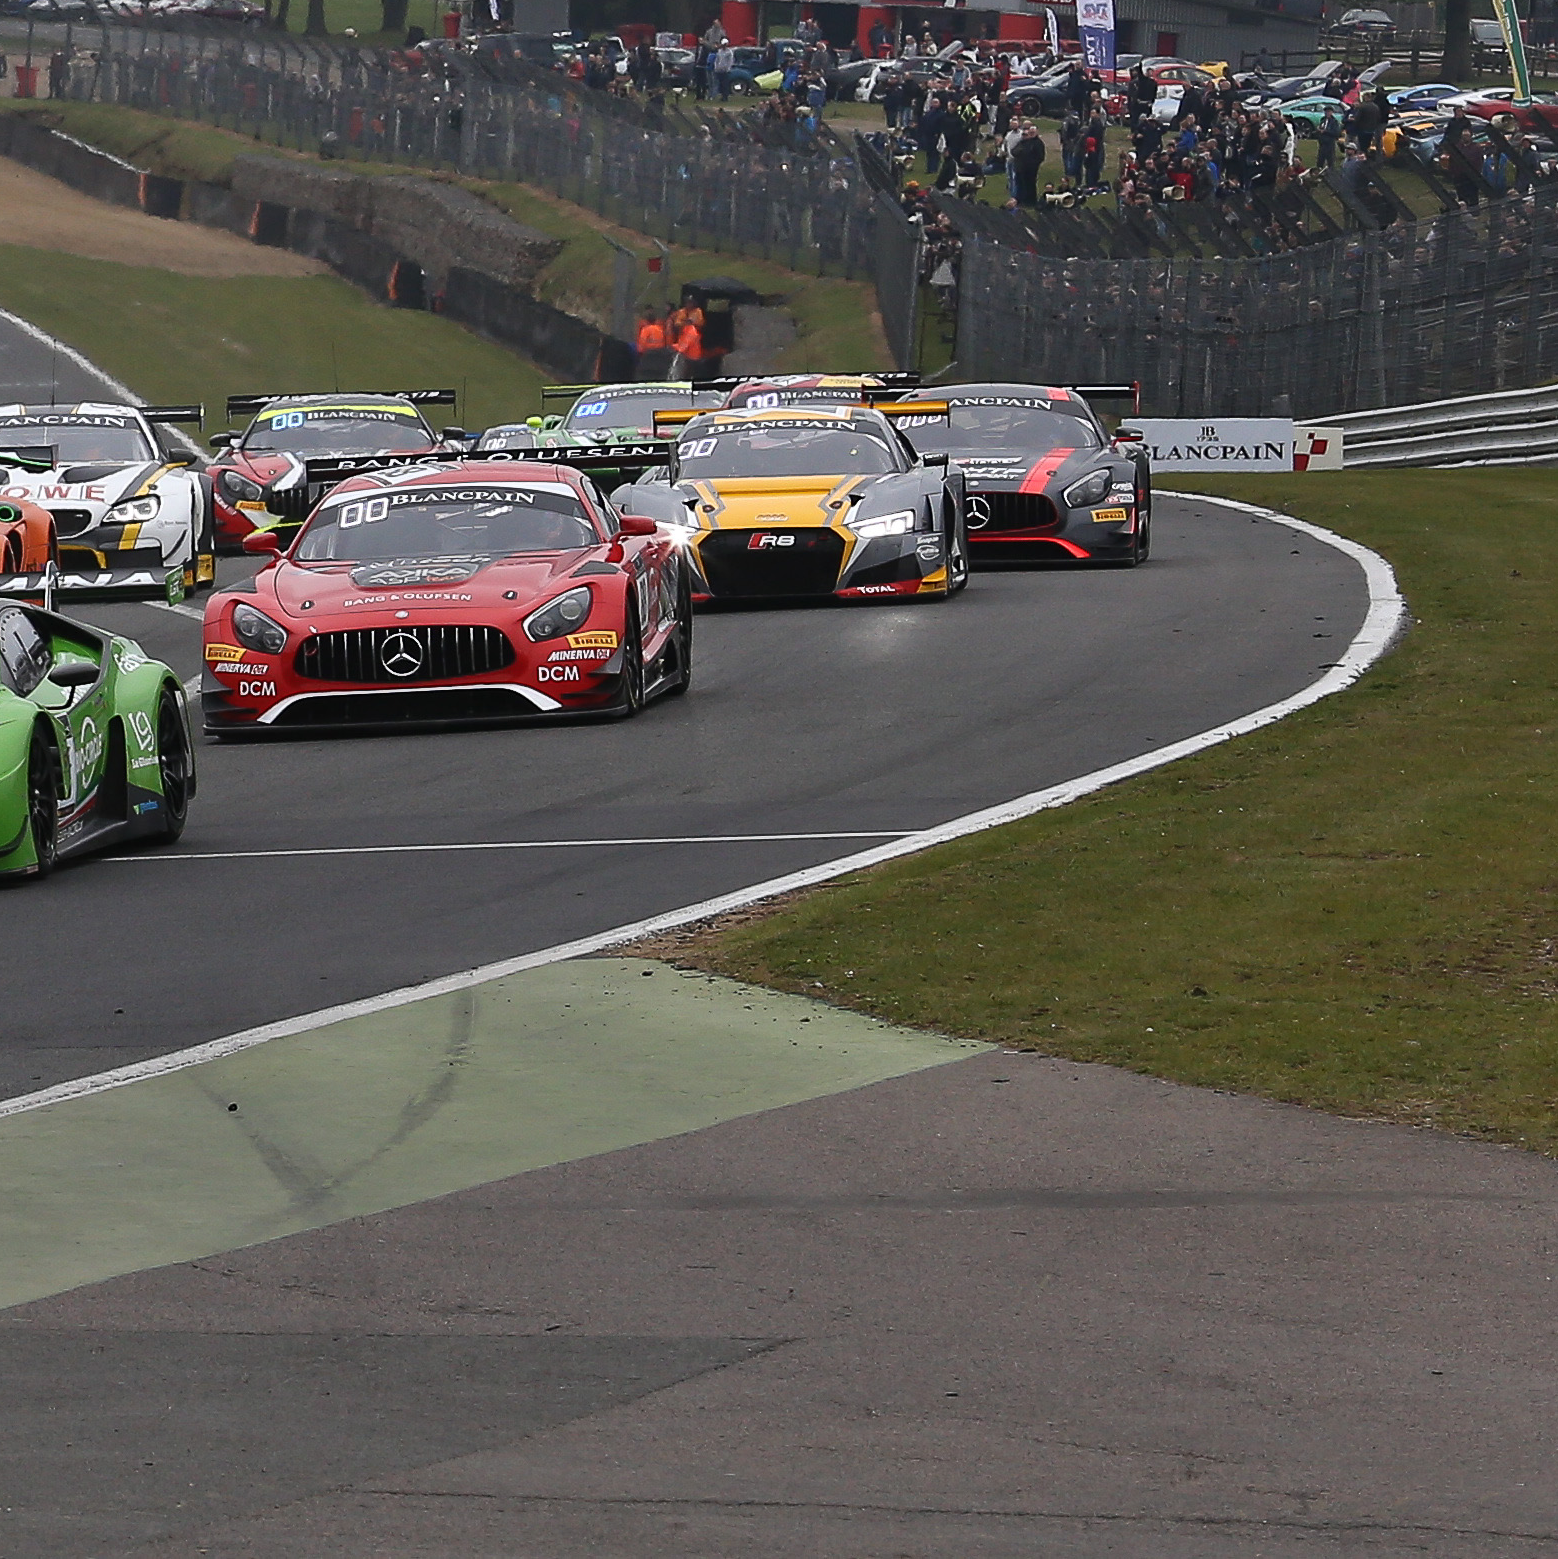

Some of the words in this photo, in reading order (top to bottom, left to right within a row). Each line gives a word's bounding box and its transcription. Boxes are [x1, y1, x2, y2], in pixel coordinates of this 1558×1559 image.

[306, 410, 397, 422] BLANCPAIN
[705, 420, 857, 437] BLANCPAIN
[391, 490, 536, 506] BLANCPAIN
[856, 585, 896, 594] TOTAL
[344, 596, 387, 608] BANG
[405, 592, 473, 603] OLUFSEN
[547, 649, 596, 661] MINERVA
[214, 662, 251, 674] MINERVA
[537, 664, 580, 683] DCM
[239, 680, 277, 697] DCM
